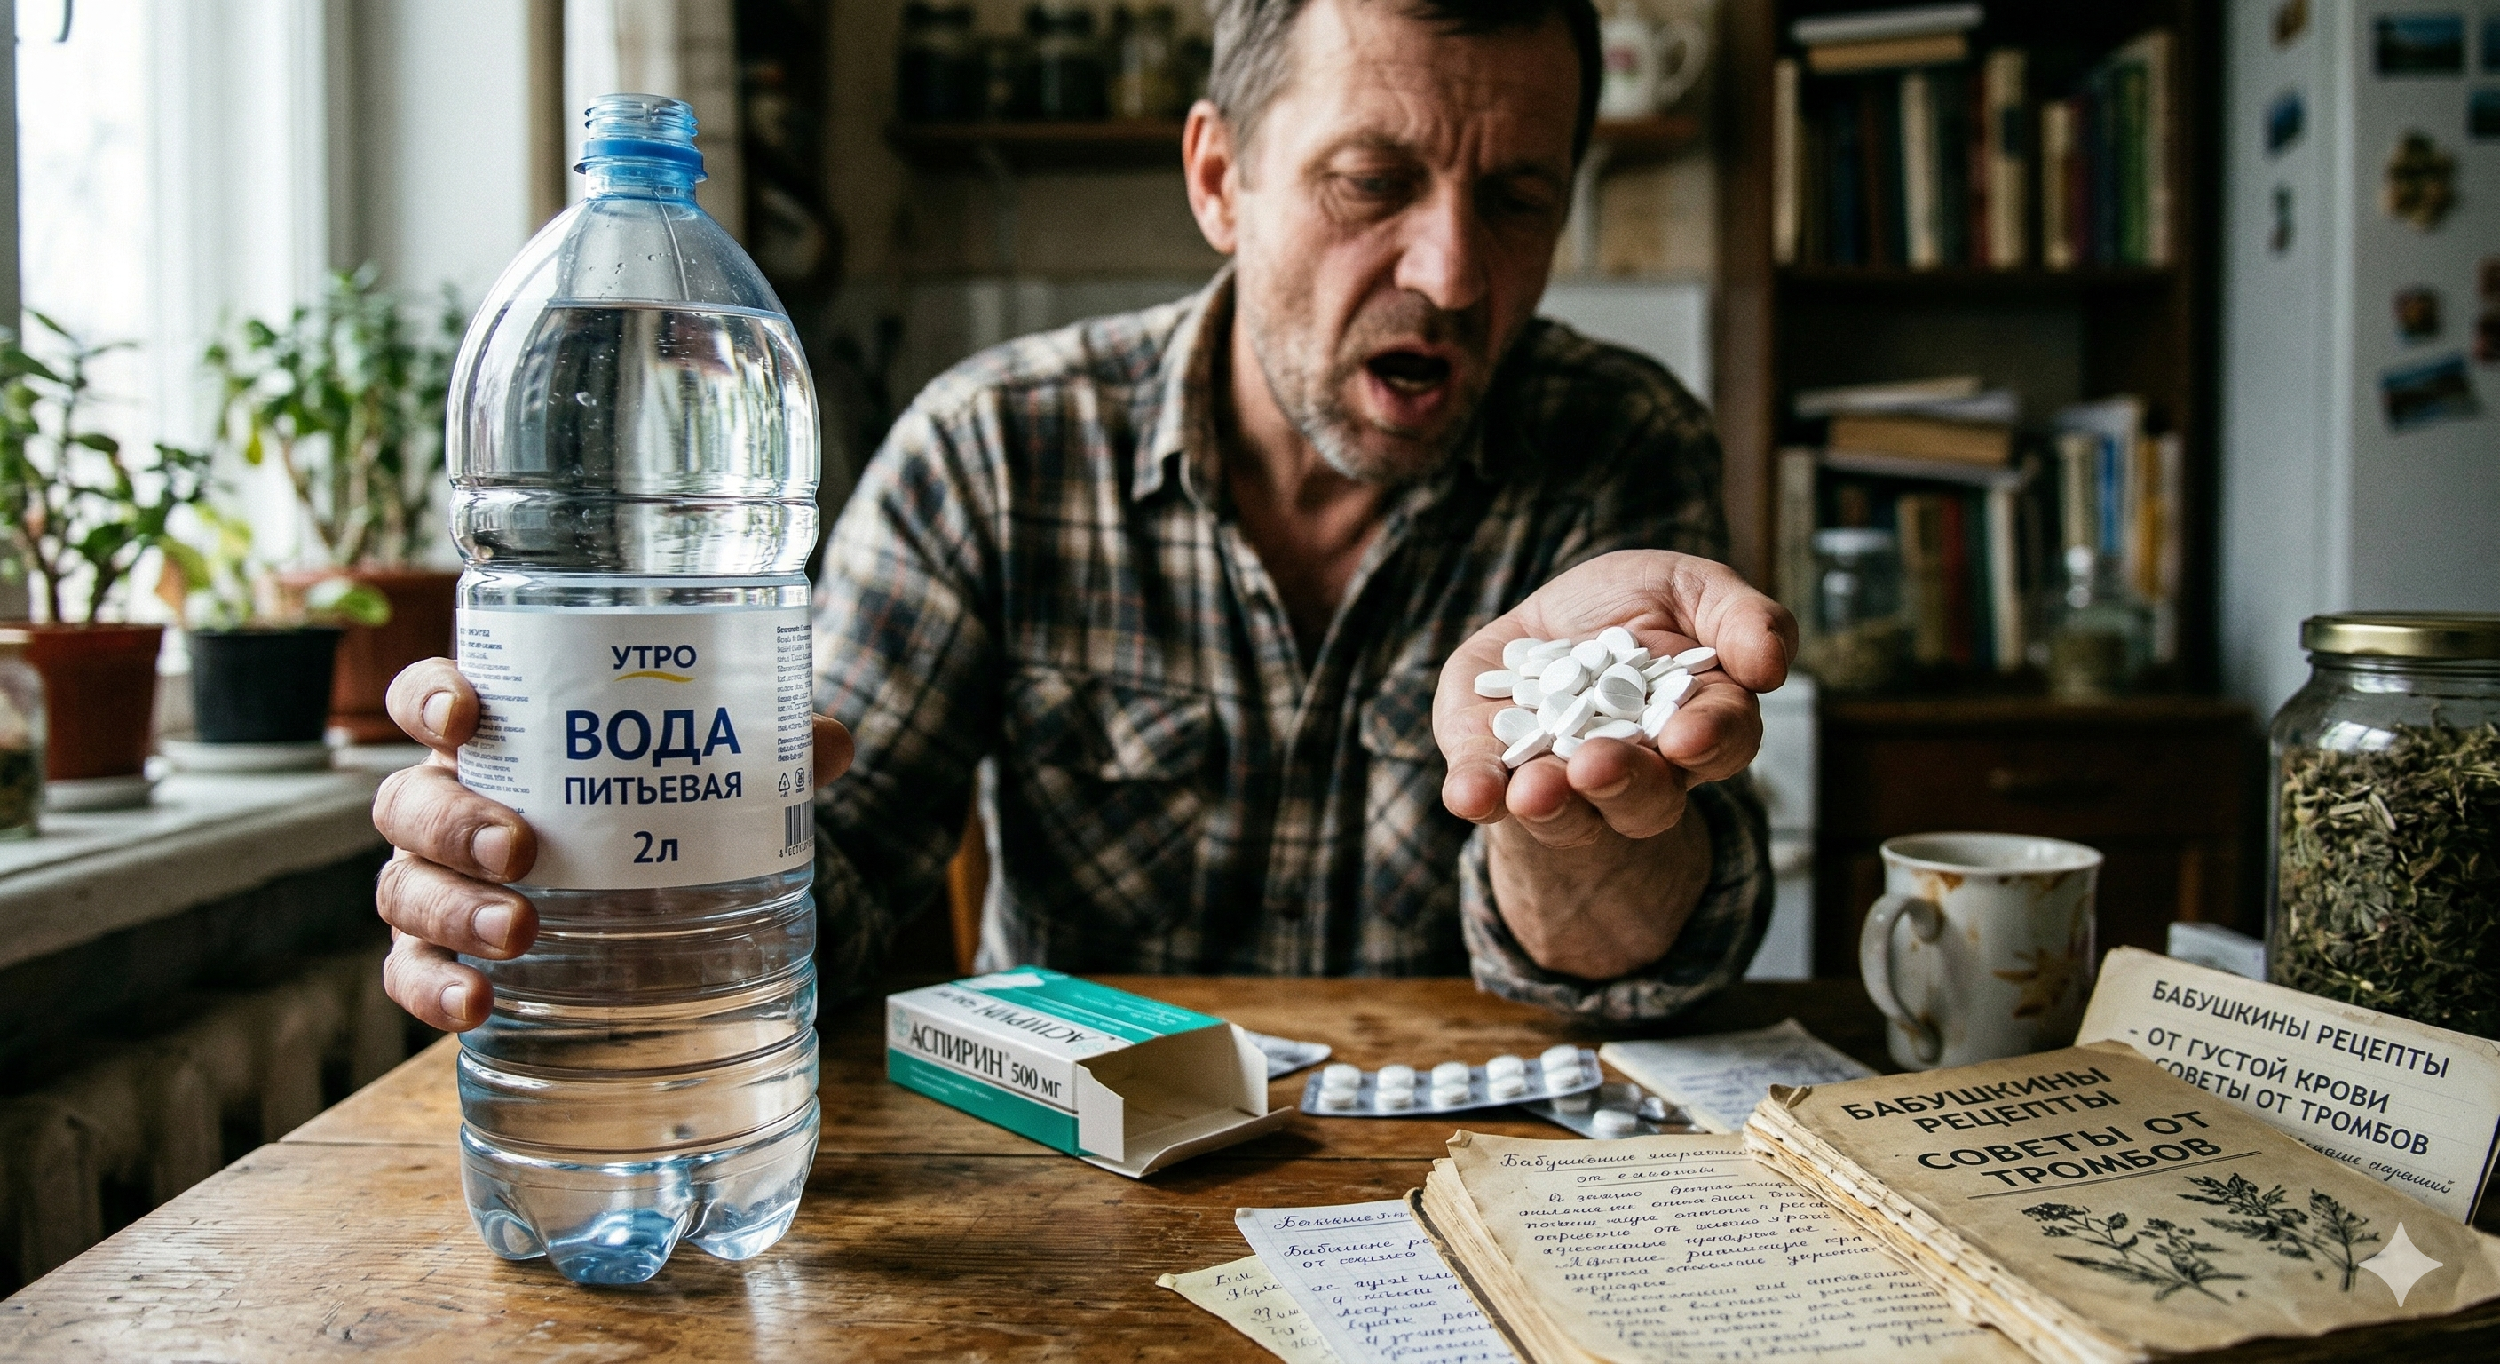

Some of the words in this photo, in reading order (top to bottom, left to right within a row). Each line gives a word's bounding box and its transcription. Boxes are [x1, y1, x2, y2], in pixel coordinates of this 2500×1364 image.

[612, 645, 697, 670] УТРО
[565, 707, 742, 768] ВОДА
[565, 771, 742, 806] ПИТЬЕВАЯ
[633, 831, 678, 863] 2л
[2152, 980, 2310, 1041] БАБУШКИНЫ
[2316, 1024, 2450, 1078] РЕЦЕПТЫ
[1011, 1062, 1039, 1091] 500
[1840, 1066, 2113, 1122] БАБУШКИНЫ
[2147, 1026, 2184, 1051] ОТ
[2187, 1038, 2288, 1084] ГУСТОЙ
[2294, 1068, 2391, 1113] КРОВИ
[1912, 1090, 2122, 1134] РЕЦЕПТЫ
[2256, 1089, 2293, 1114] ОТ
[2300, 1098, 2430, 1155] ТРОМБОВ
[1917, 1124, 2136, 1170] СОВЕТЫ
[2143, 1110, 2211, 1136] ОТ
[1981, 1137, 2223, 1188] ТРОМБОВ
